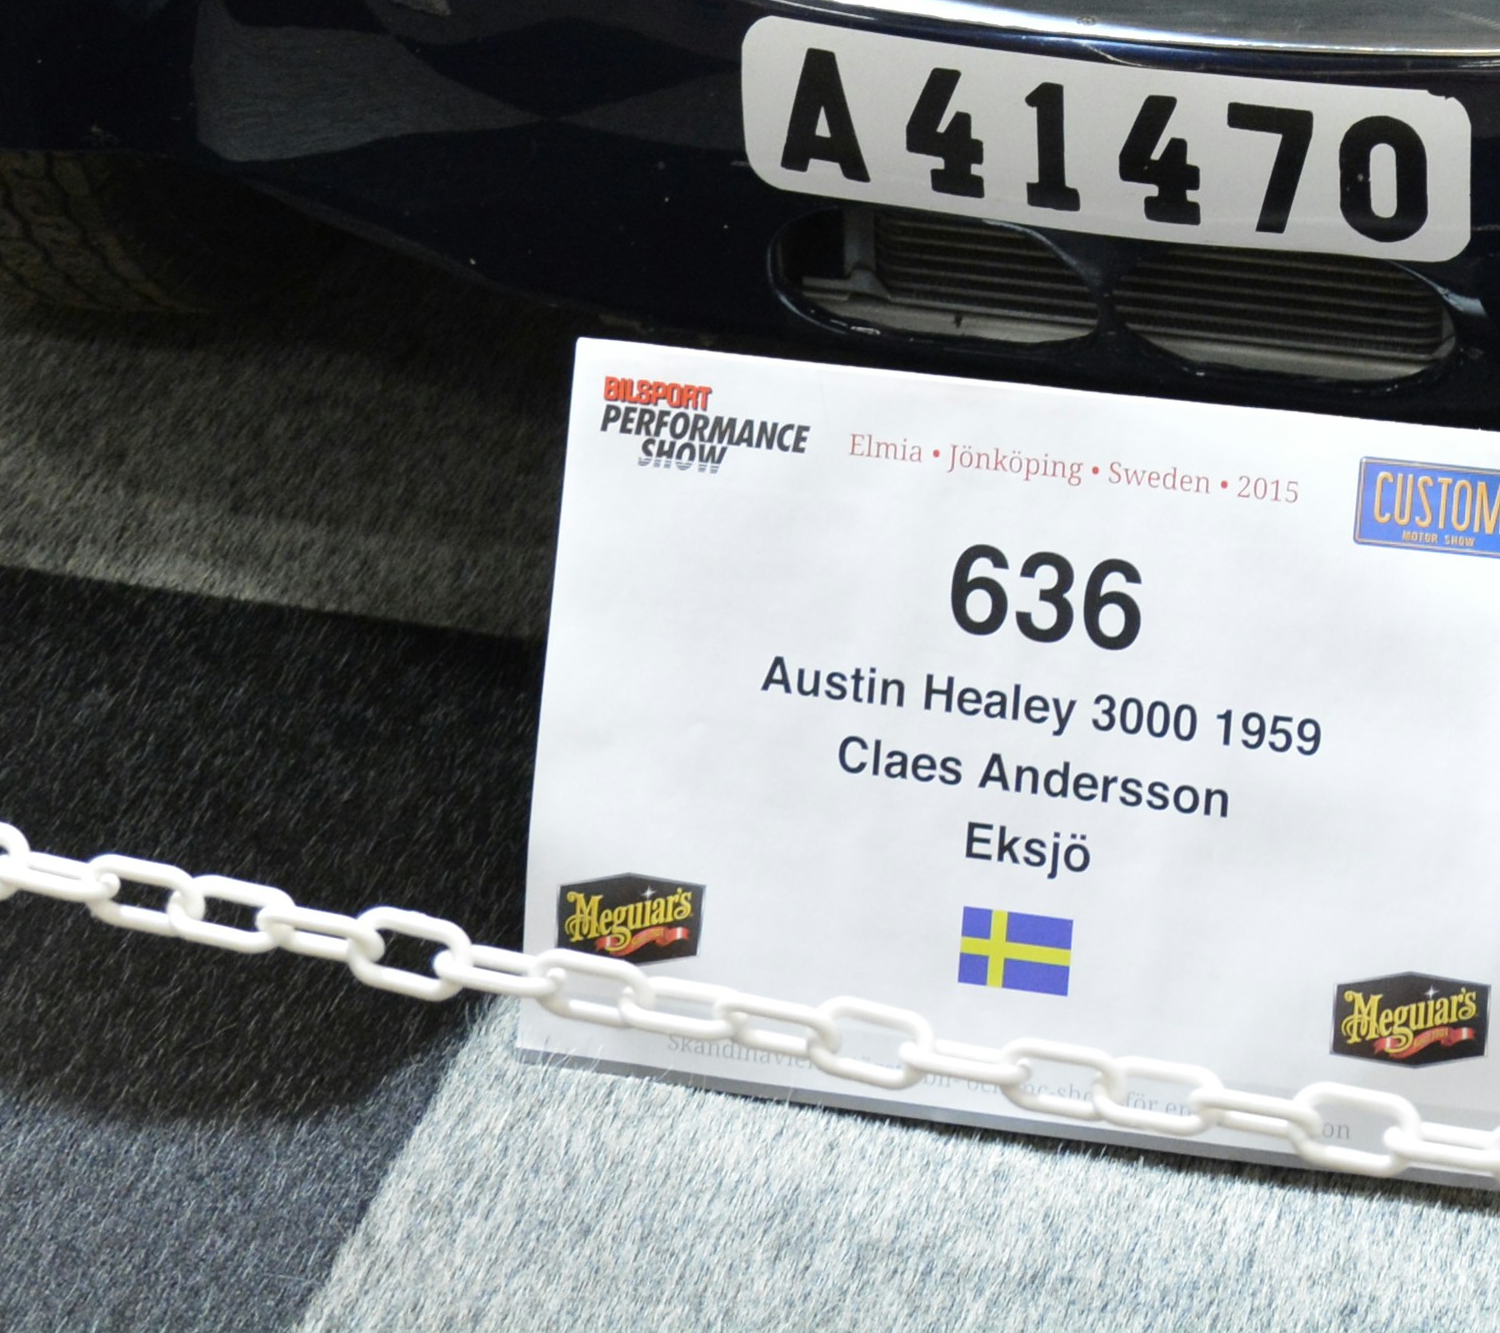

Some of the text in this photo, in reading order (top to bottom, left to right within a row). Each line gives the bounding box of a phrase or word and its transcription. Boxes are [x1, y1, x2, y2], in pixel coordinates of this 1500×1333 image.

[603, 376, 712, 411] BILSPORT
[600, 404, 811, 454] PERFORMANCE
[638, 438, 728, 474] SHOW
[849, 432, 1300, 504] Elmia Jönköping Sweden 2015
[1402, 530, 1476, 547] MOTOR SHOW
[950, 543, 1142, 651] 636
[760, 655, 1323, 756] Austin Healey 3000 1959
[837, 735, 1231, 818] Claes Andersson
[965, 821, 1091, 880] Eksjö
[564, 887, 693, 952] Meguiar's
[1341, 987, 1477, 1053] Meguiar's
